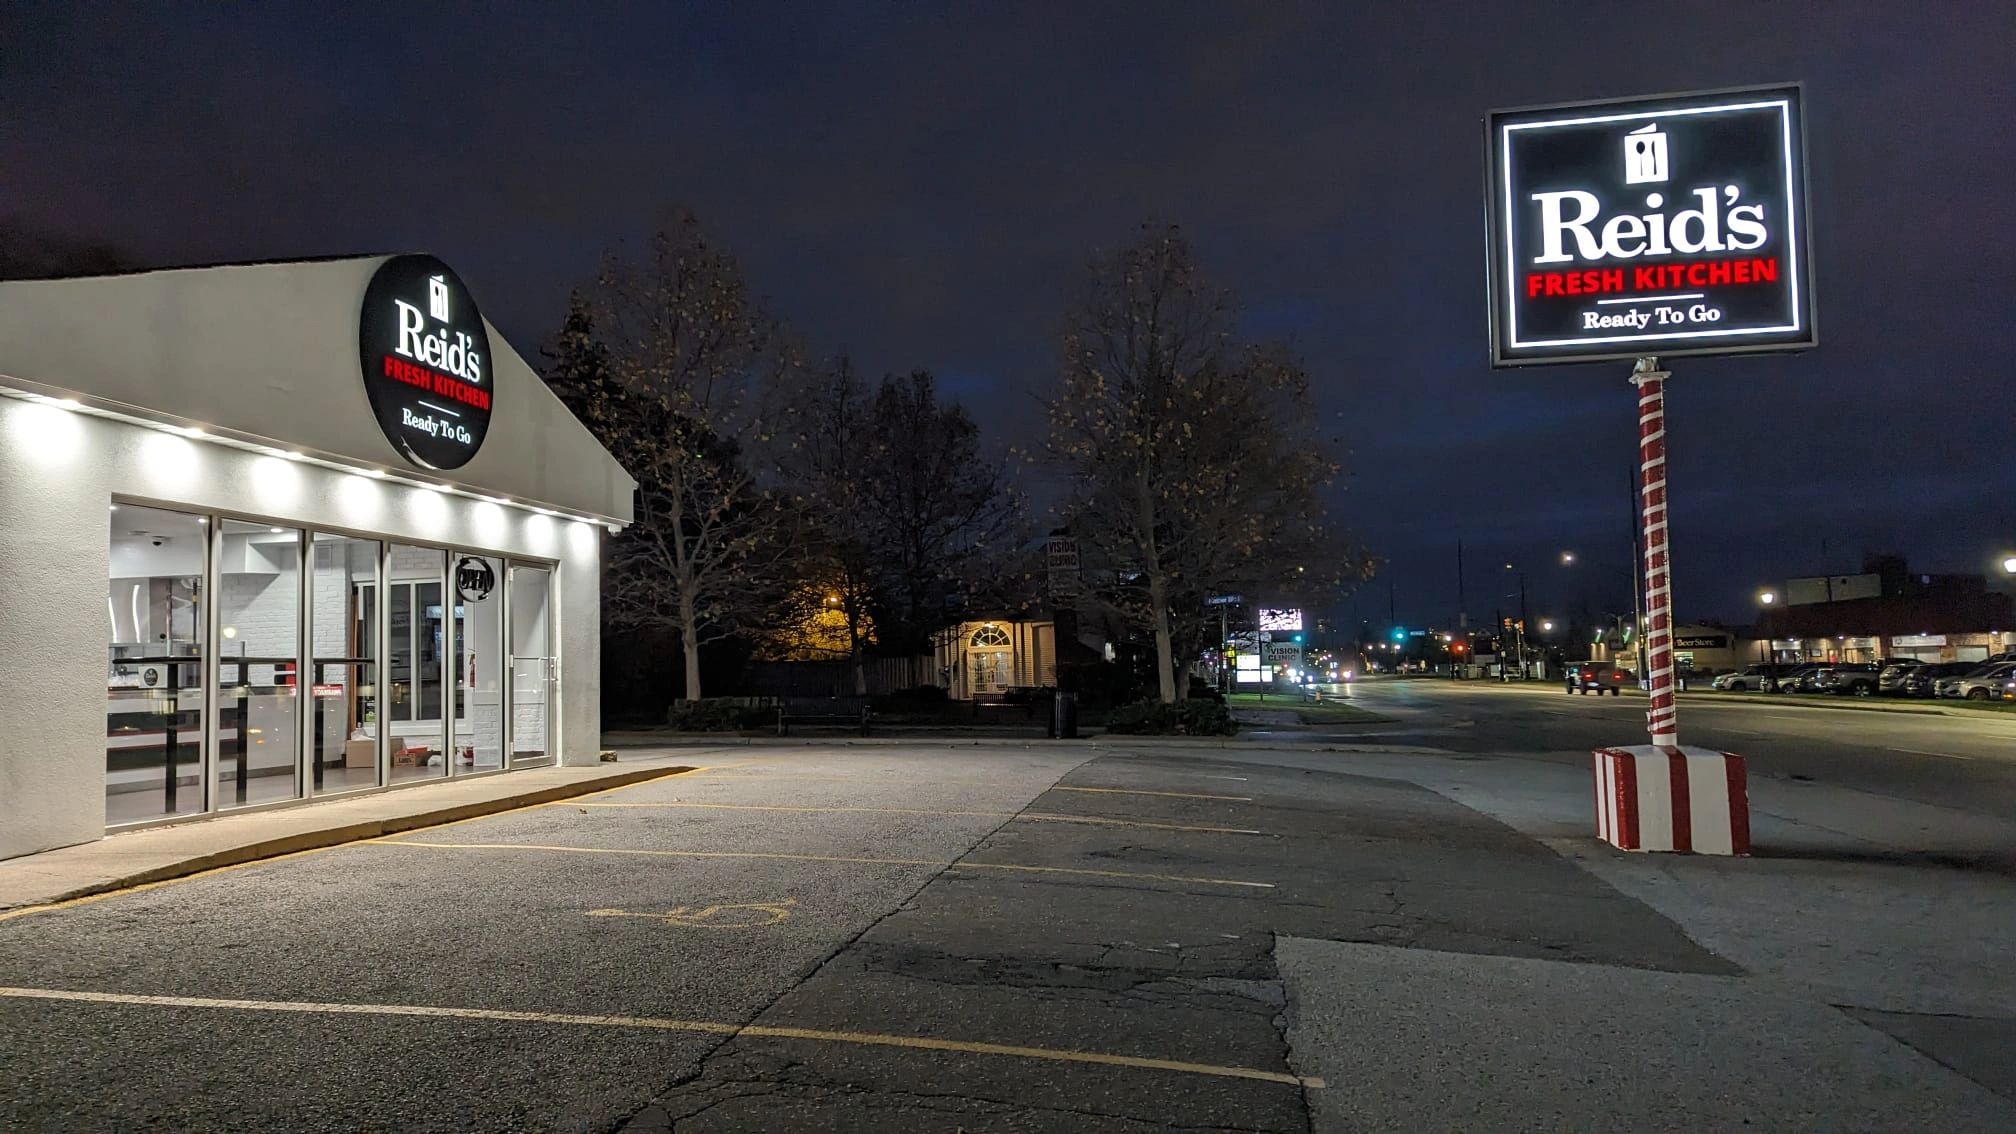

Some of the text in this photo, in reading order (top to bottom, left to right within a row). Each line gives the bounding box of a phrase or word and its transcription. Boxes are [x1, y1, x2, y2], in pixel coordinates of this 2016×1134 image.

[1531, 184, 1768, 264] Reid's
[1527, 257, 1777, 297] FRESH KITCHEN
[1583, 304, 1721, 329] Ready To Go
[394, 298, 481, 383] Reid's
[383, 355, 490, 410] FRESH KITCHEN
[402, 407, 471, 445] Ready To Go
[459, 567, 493, 592] OPEN
[1270, 647, 1300, 655] VISION
